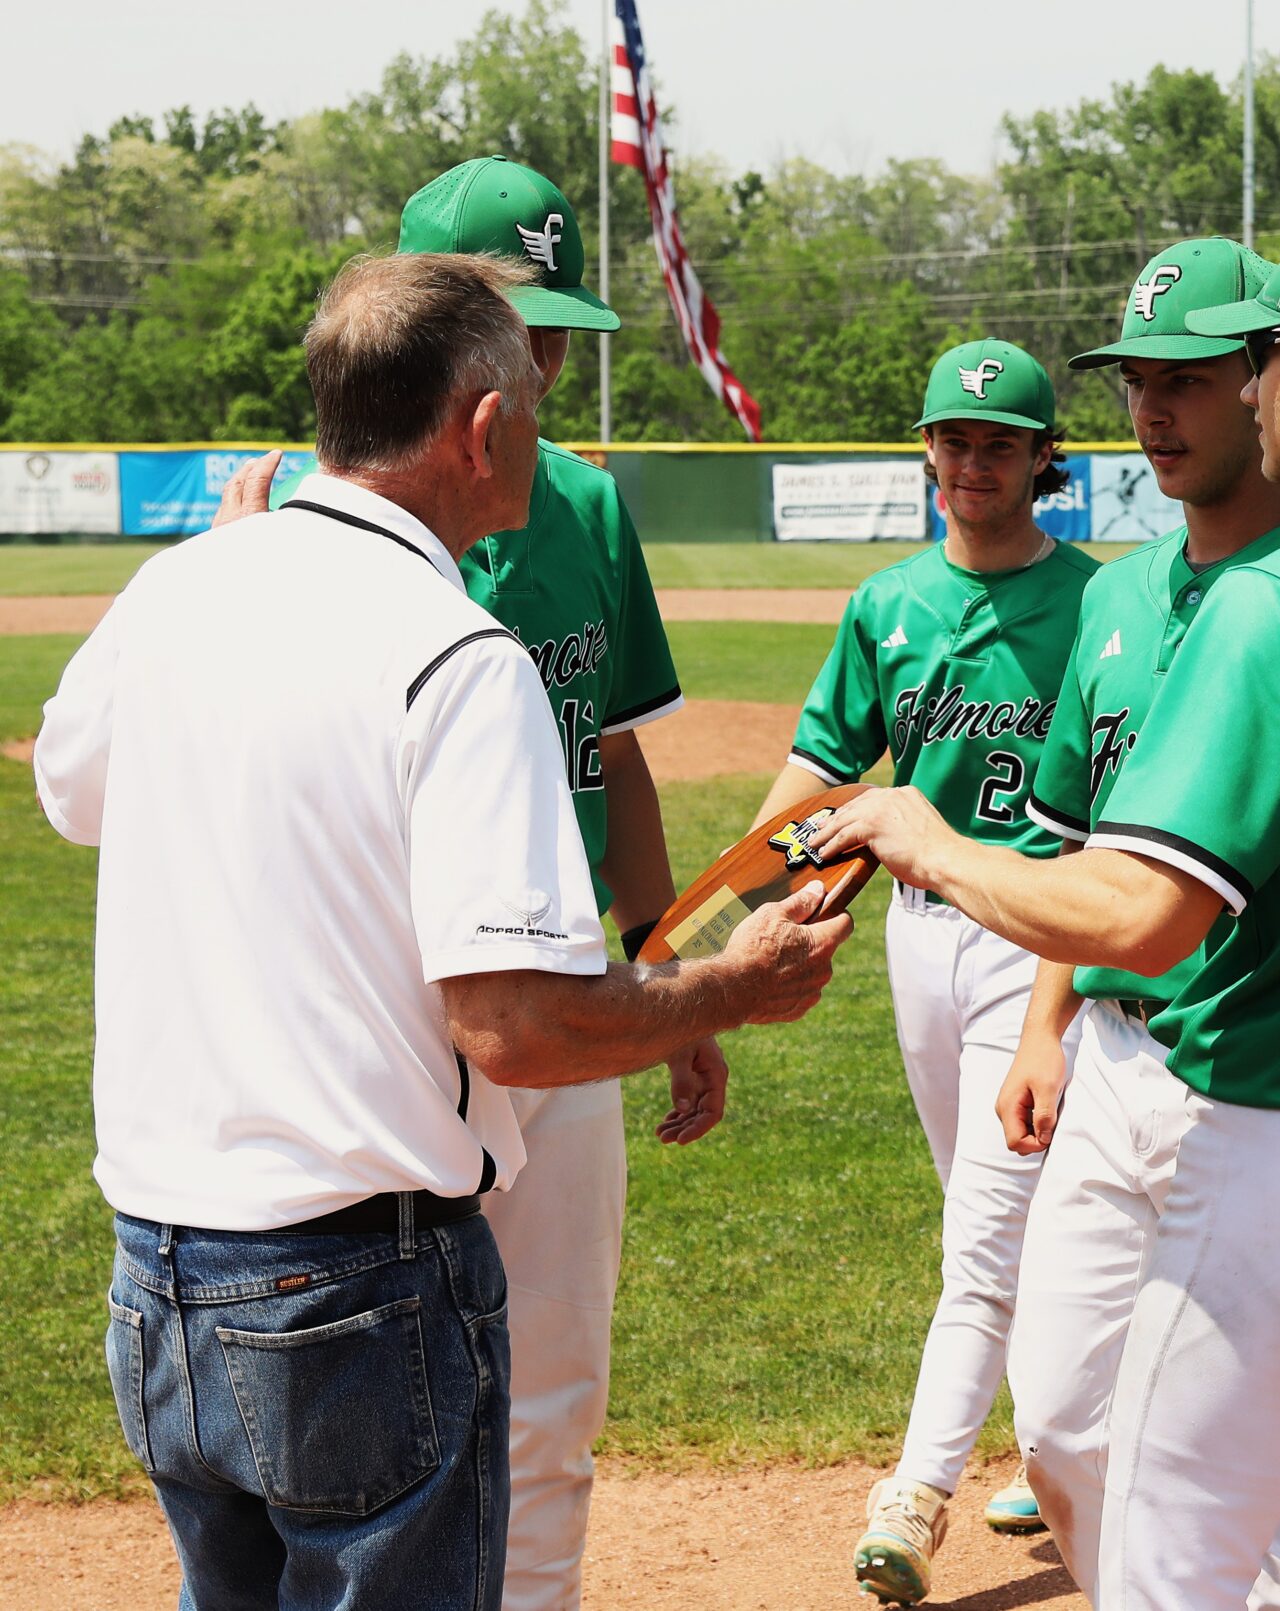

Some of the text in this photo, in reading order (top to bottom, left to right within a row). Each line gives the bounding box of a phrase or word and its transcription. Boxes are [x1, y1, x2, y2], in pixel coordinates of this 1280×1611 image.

[1033, 479, 1084, 518] psi
[894, 680, 1060, 764] Filmore
[975, 750, 1026, 824] 2
[476, 925, 524, 935] ADPRO
